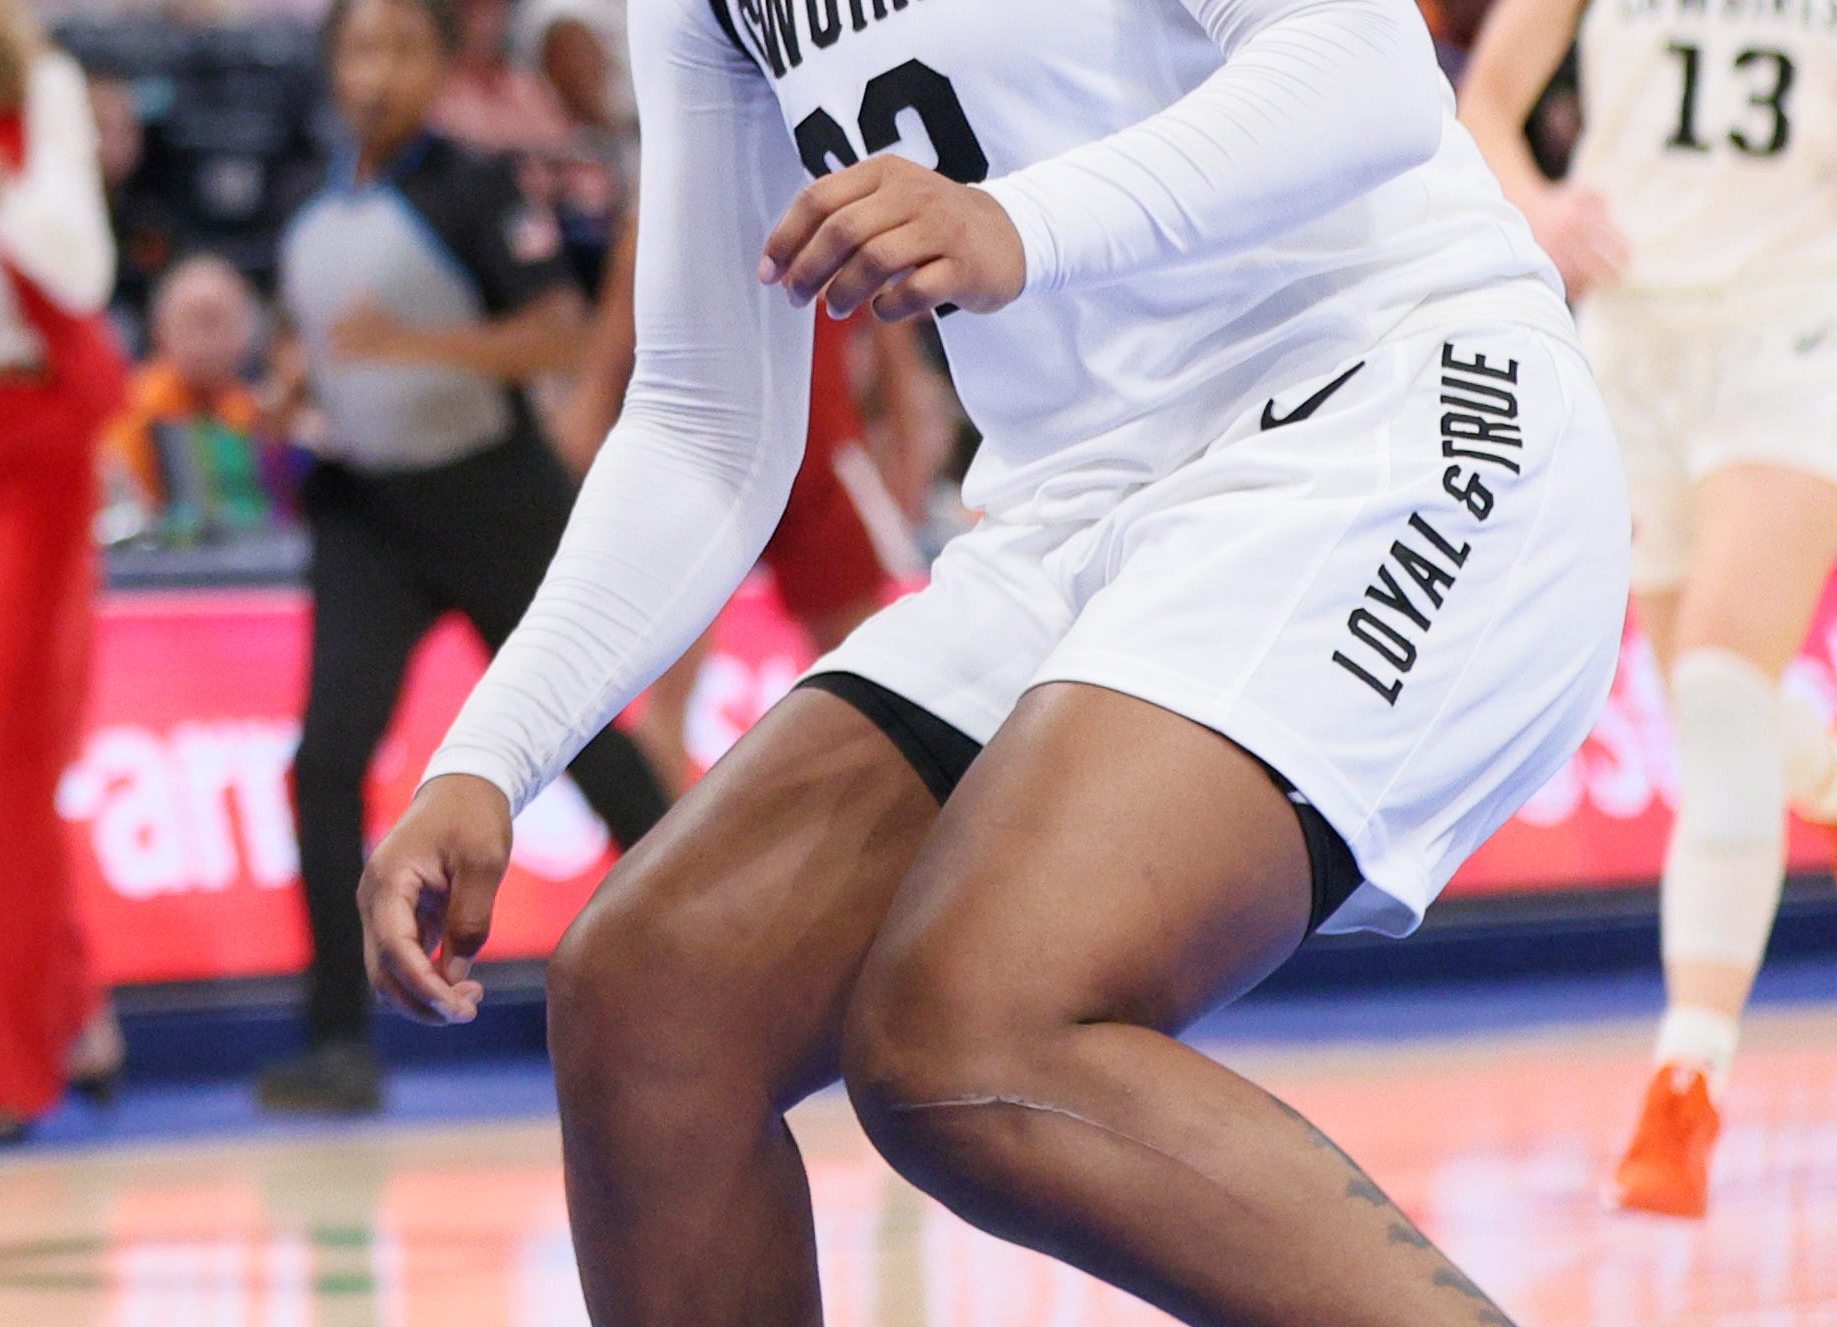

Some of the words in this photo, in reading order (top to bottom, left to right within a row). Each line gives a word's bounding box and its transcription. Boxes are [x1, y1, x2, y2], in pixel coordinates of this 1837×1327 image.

[1662, 36, 1797, 156] 13
[1440, 341, 1523, 475] TRUE
[1442, 464, 1495, 521] &
[1331, 511, 1472, 707] LOYAL
